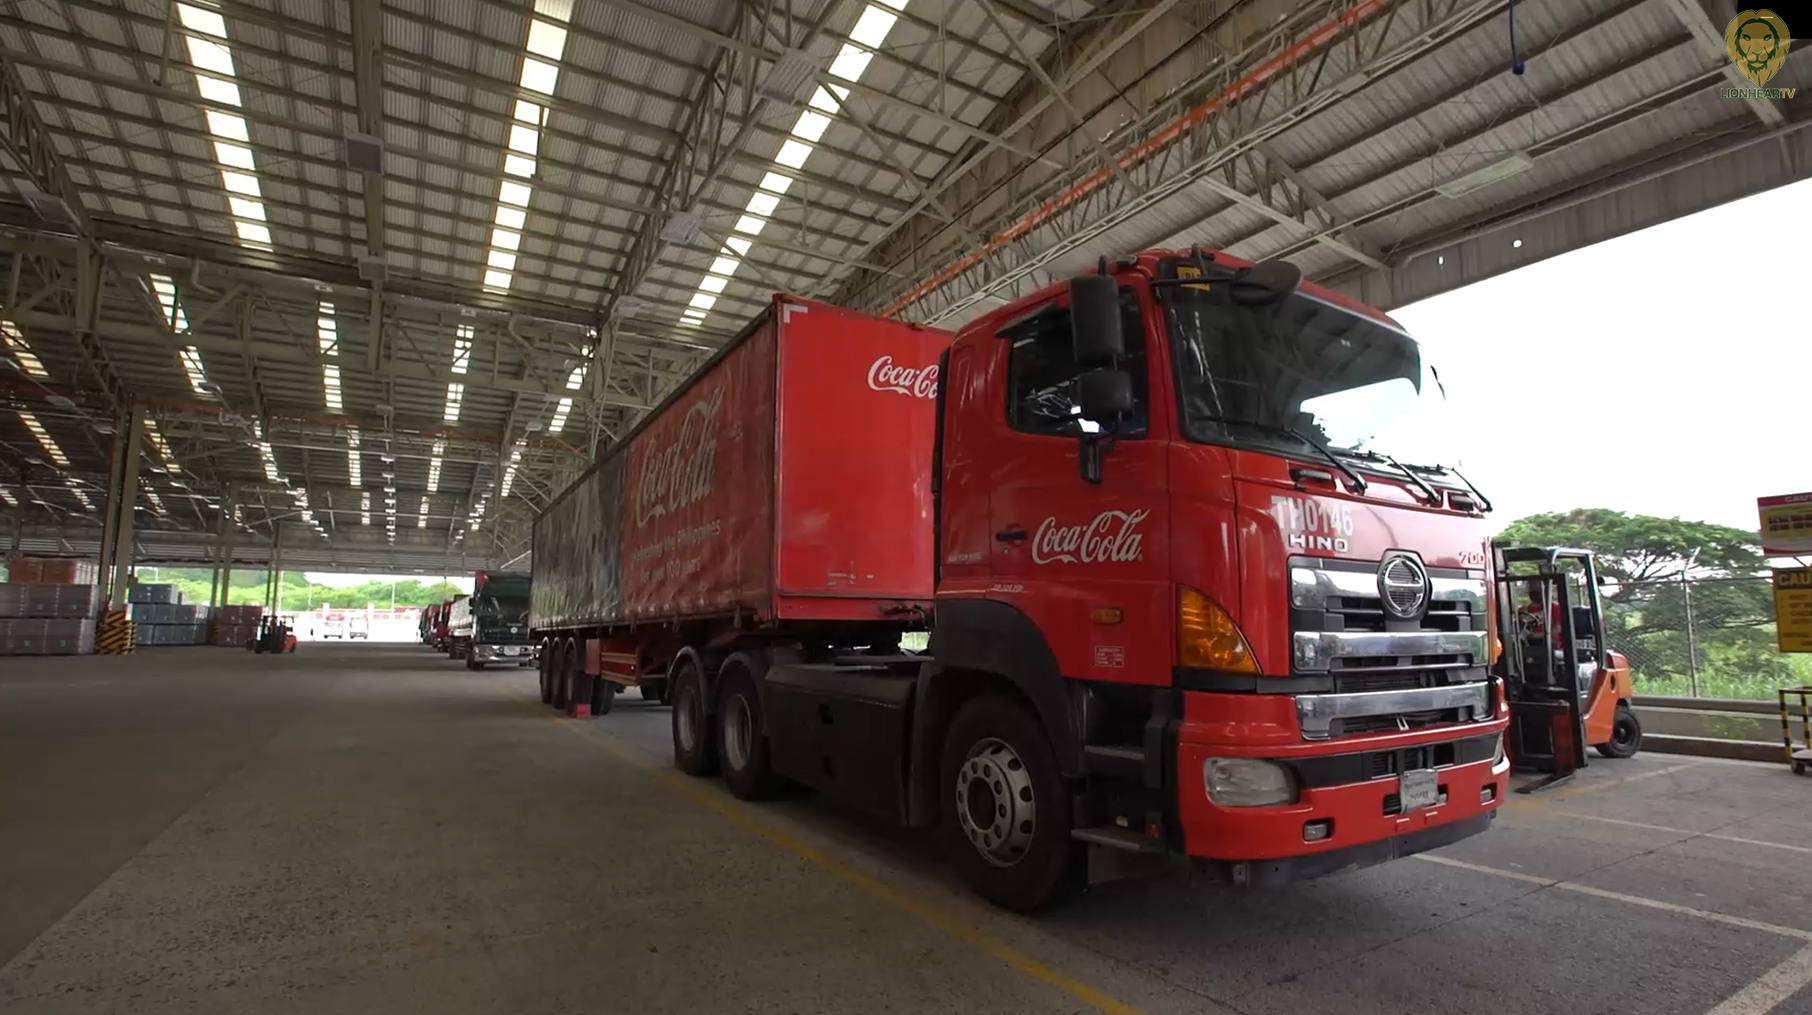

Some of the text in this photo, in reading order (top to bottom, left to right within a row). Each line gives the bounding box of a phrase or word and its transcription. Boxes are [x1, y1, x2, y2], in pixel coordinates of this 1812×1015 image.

[635, 386, 726, 528] Coca-Cola
[1032, 508, 1151, 565] Coca-Cola
[1289, 533, 1349, 553] HINO
[666, 557, 681, 580] 100
